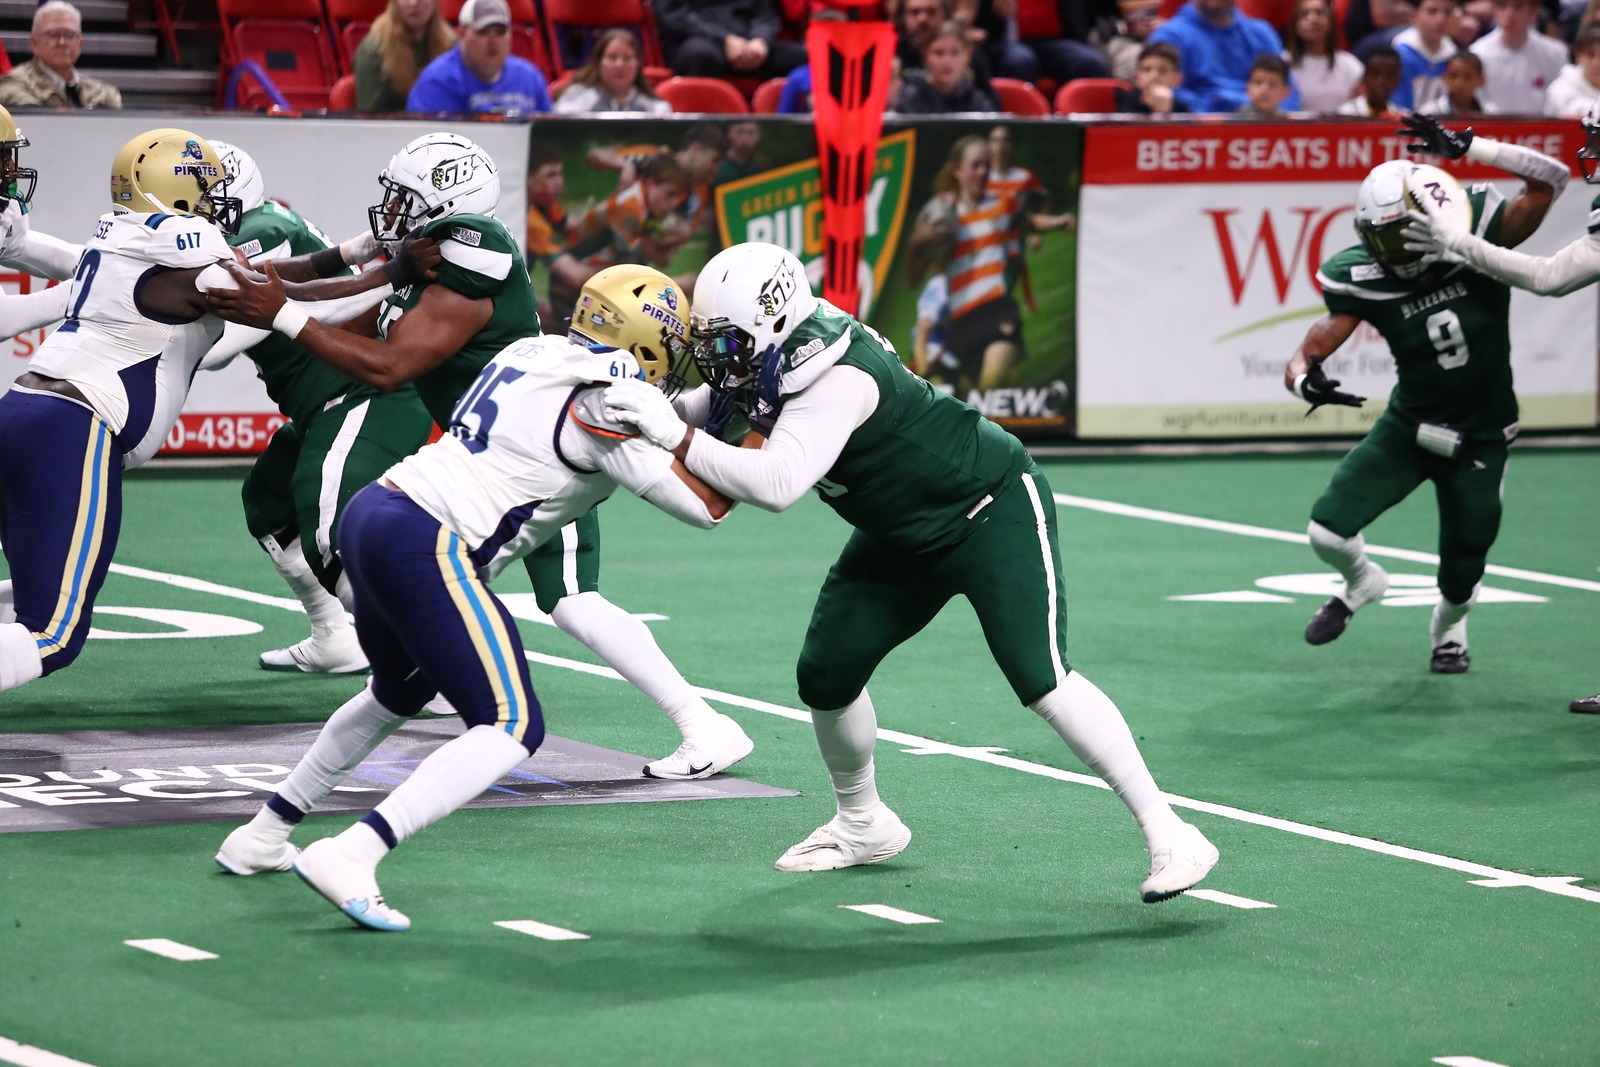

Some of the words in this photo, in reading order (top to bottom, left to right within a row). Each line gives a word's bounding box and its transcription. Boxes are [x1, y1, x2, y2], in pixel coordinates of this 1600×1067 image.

[1137, 138, 1222, 171] BEST
[1227, 136, 1330, 170] SEATS
[1336, 136, 1372, 168] IN
[176, 232, 201, 251] 617
[1400, 281, 1468, 320] BLIZZARD
[642, 303, 685, 337] PIRATES
[1426, 309, 1470, 371] 9
[610, 360, 633, 379] 61
